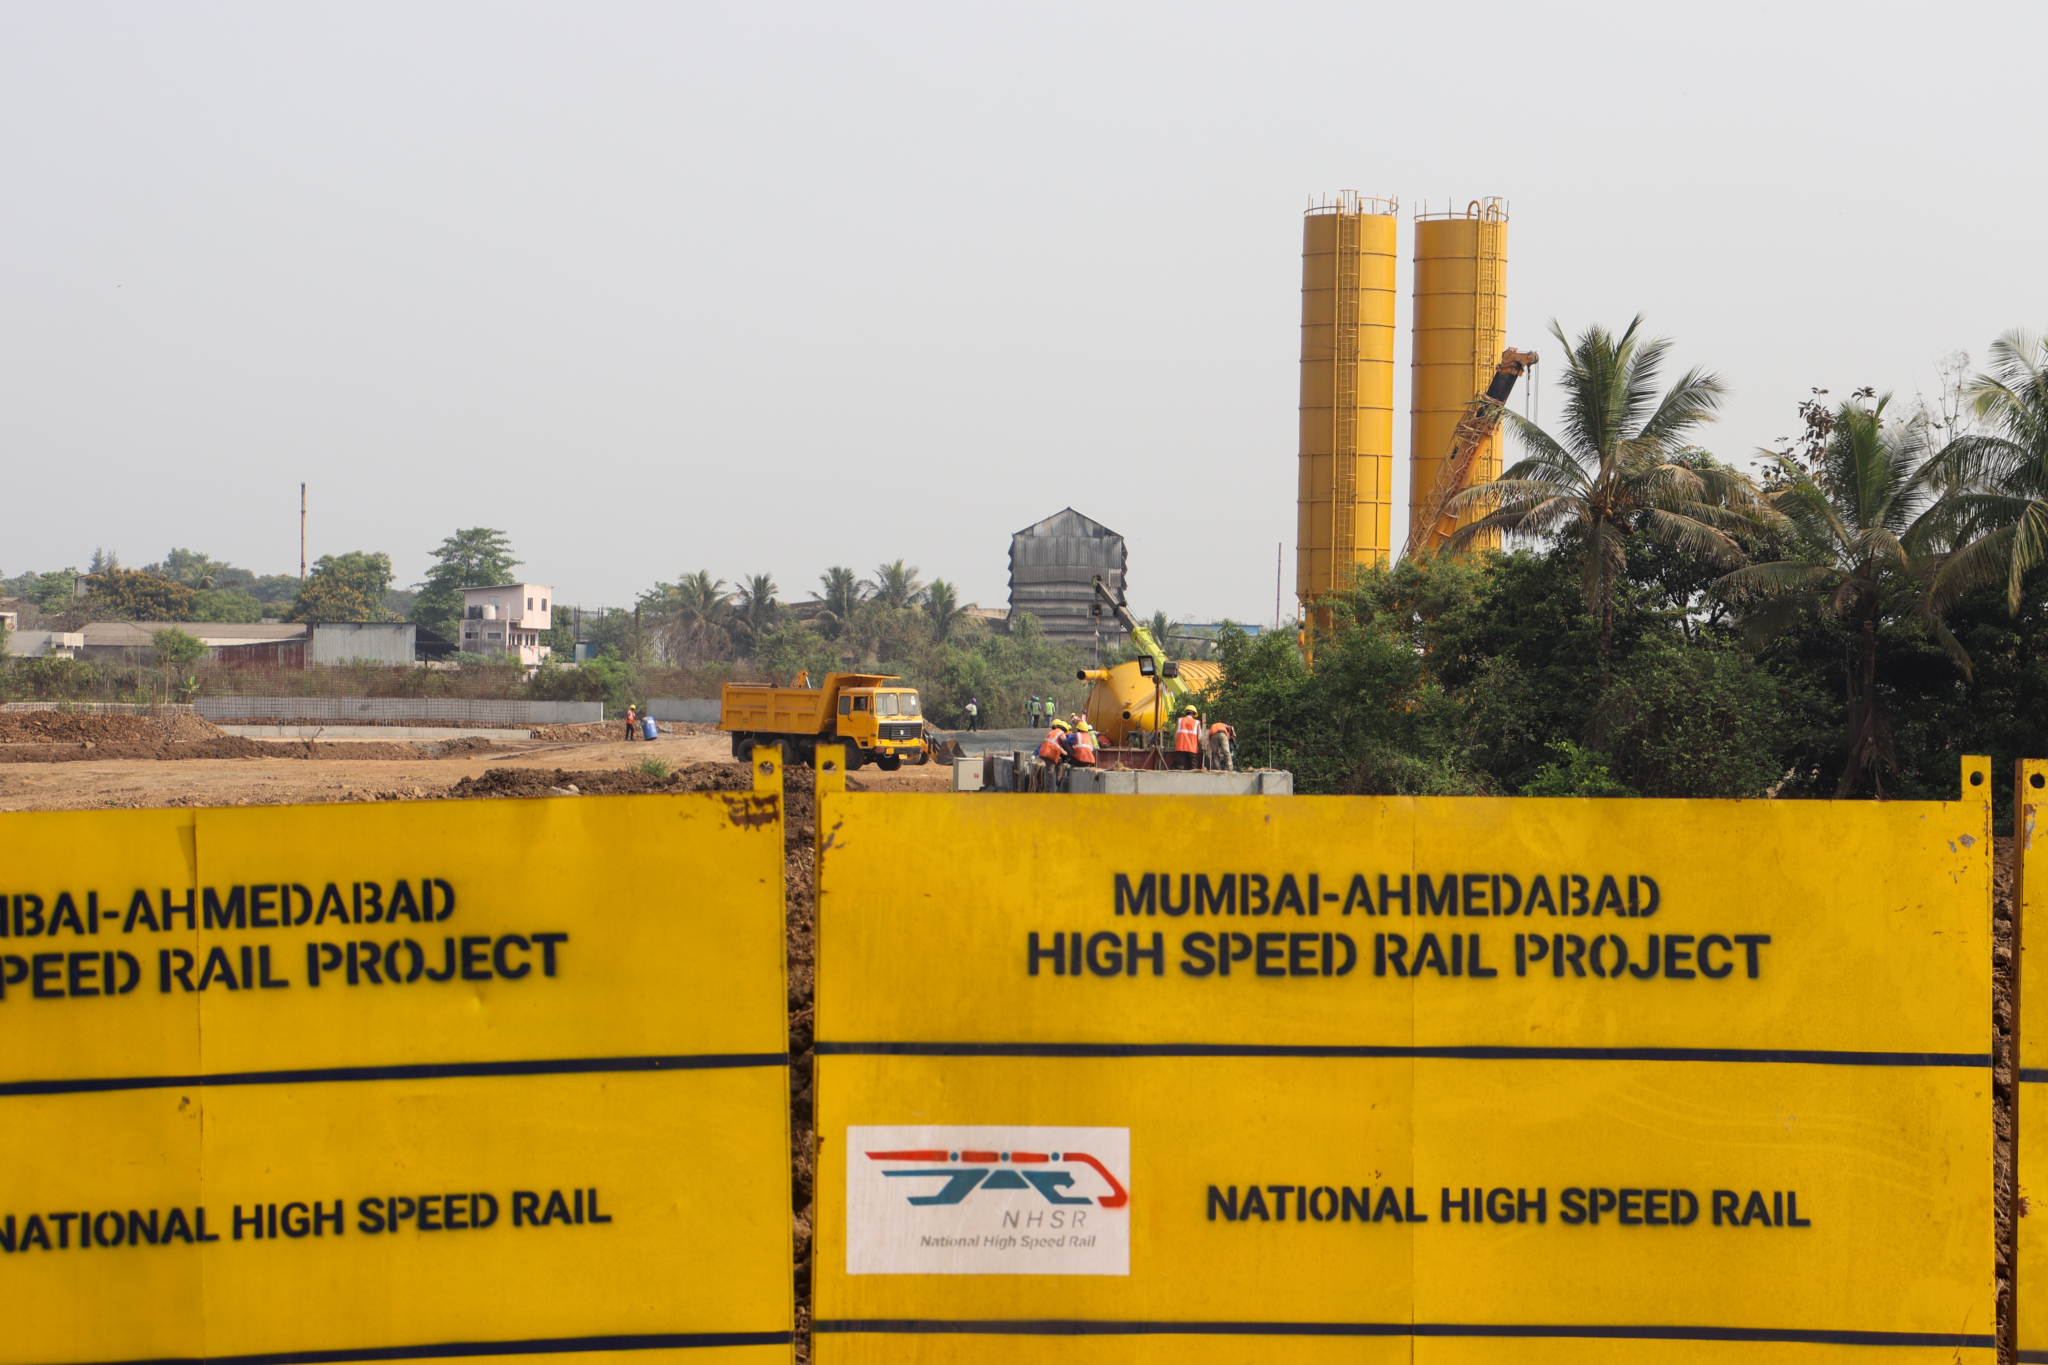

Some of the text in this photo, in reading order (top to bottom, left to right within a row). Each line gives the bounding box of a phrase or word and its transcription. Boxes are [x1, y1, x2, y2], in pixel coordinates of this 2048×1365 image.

[0, 877, 456, 939] BAI-AHMEDABAD
[1114, 872, 1661, 918] MUMBAI-AHMEDABAD
[158, 944, 290, 995] RAIL
[306, 931, 570, 988] PROJECT
[1027, 930, 1773, 981] HIGH SPEED RAIL PROJECT
[232, 1199, 345, 1241] HIGH
[357, 1191, 500, 1236] SPEED
[511, 1187, 613, 1228] RAIL
[1206, 1184, 1812, 1228] NATIONAL HIGH SPEED RAIL
[919, 1234, 1097, 1251] National High Speed Rail
